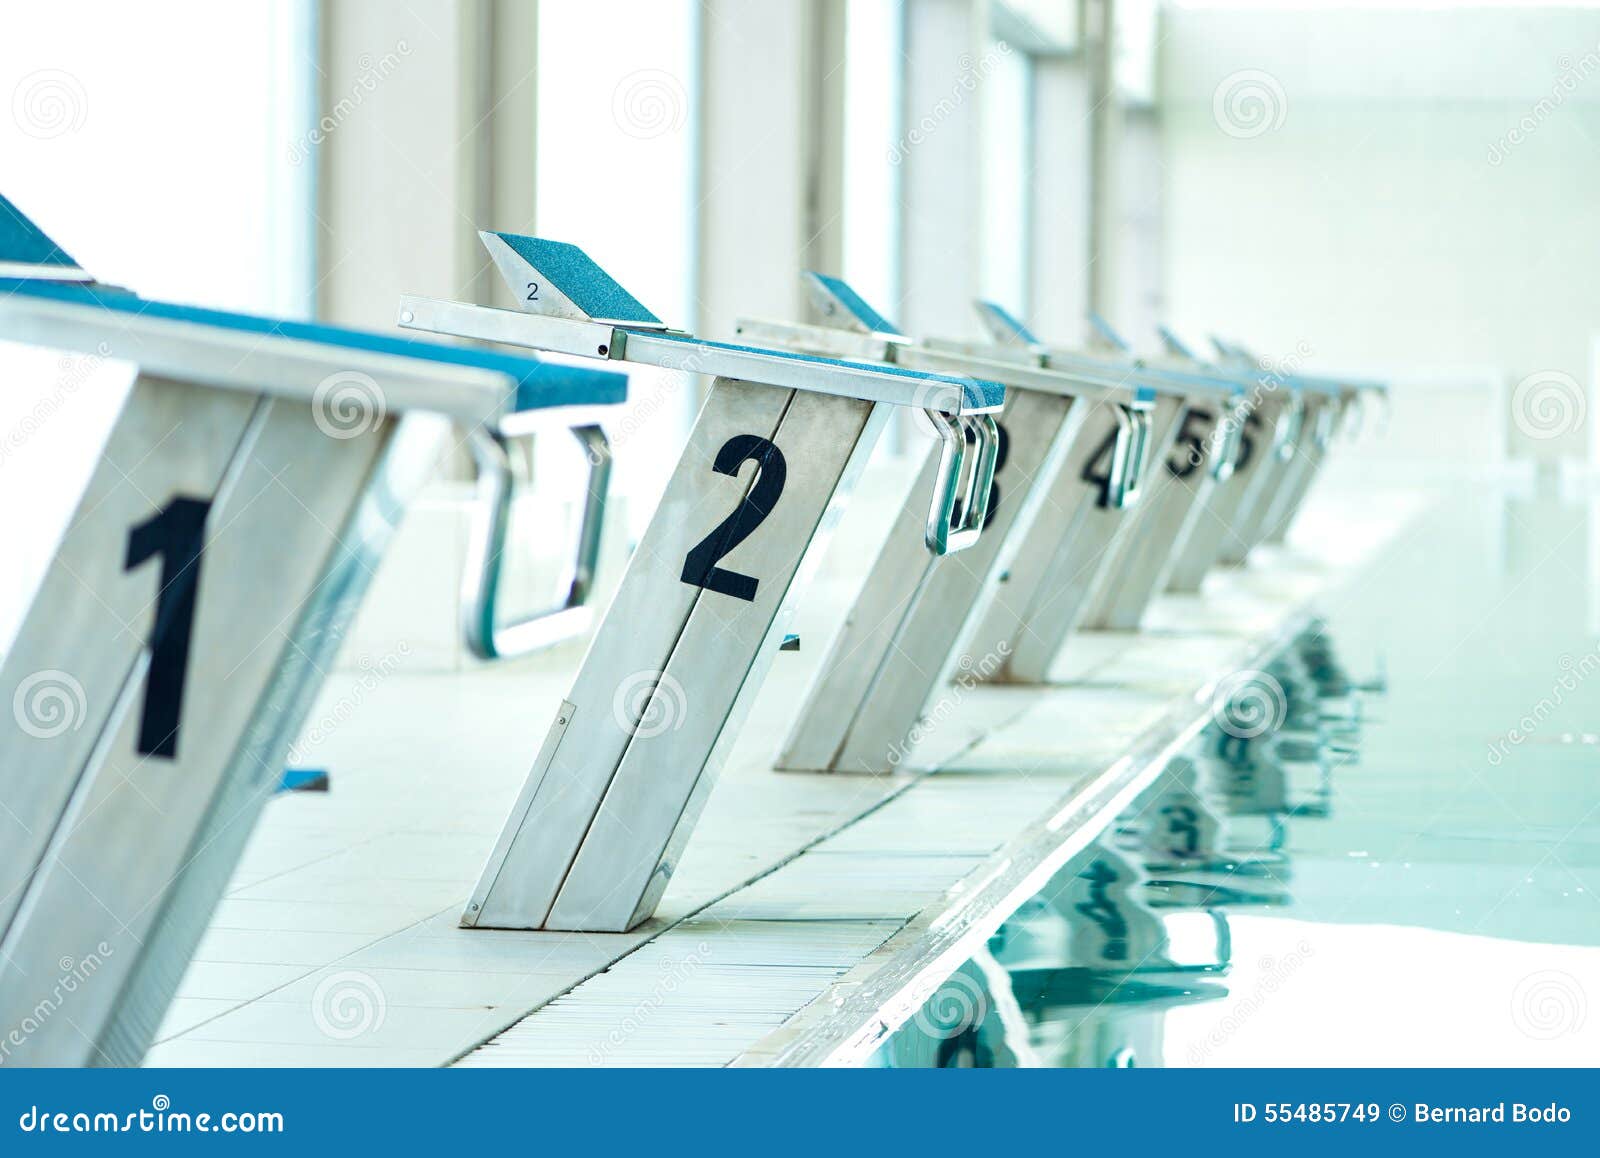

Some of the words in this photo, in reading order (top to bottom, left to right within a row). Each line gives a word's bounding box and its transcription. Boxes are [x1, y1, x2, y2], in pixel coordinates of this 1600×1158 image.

[527, 282, 539, 301] 2
[1165, 408, 1212, 479] 5
[681, 434, 787, 601] 2
[122, 492, 212, 761] 1
